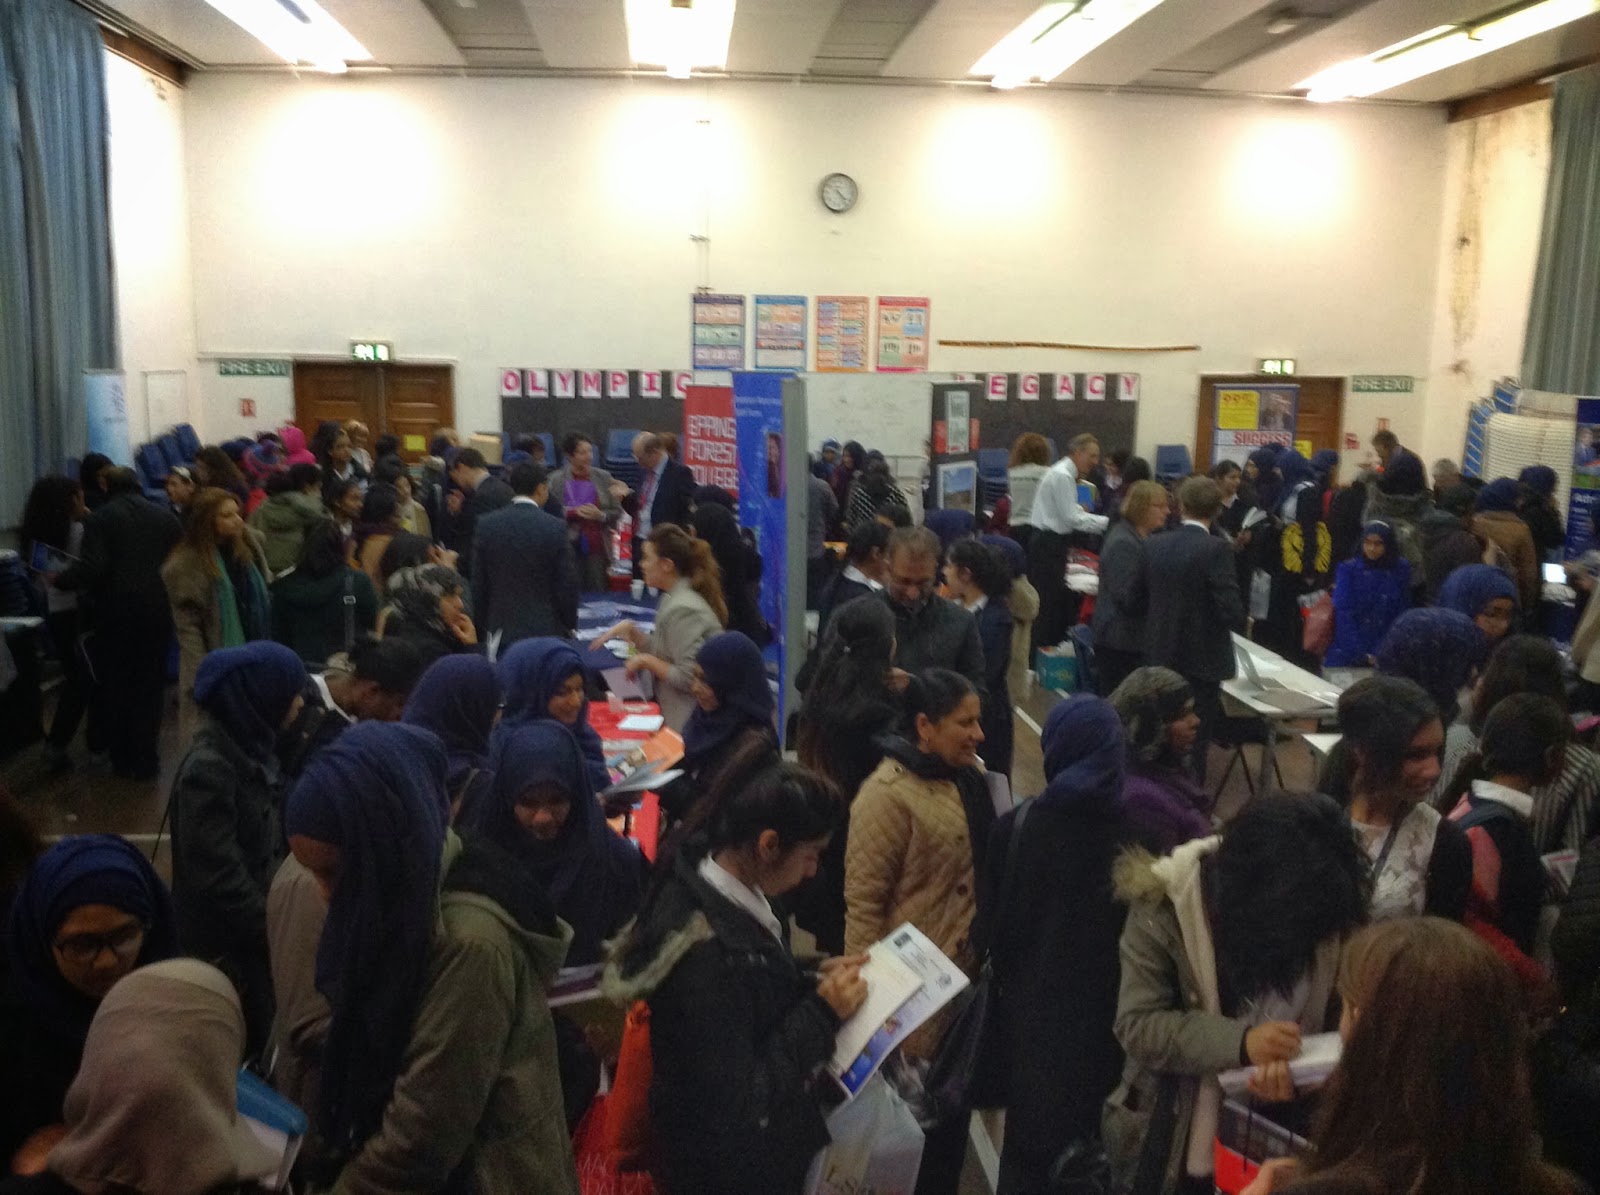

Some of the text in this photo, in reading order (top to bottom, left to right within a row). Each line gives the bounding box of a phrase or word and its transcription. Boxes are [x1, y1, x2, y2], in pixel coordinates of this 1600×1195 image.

[503, 369, 692, 393] OLYMPIC
[955, 374, 1137, 396] EGACY
[687, 414, 737, 440] EPPING
[687, 438, 738, 465] FOREST
